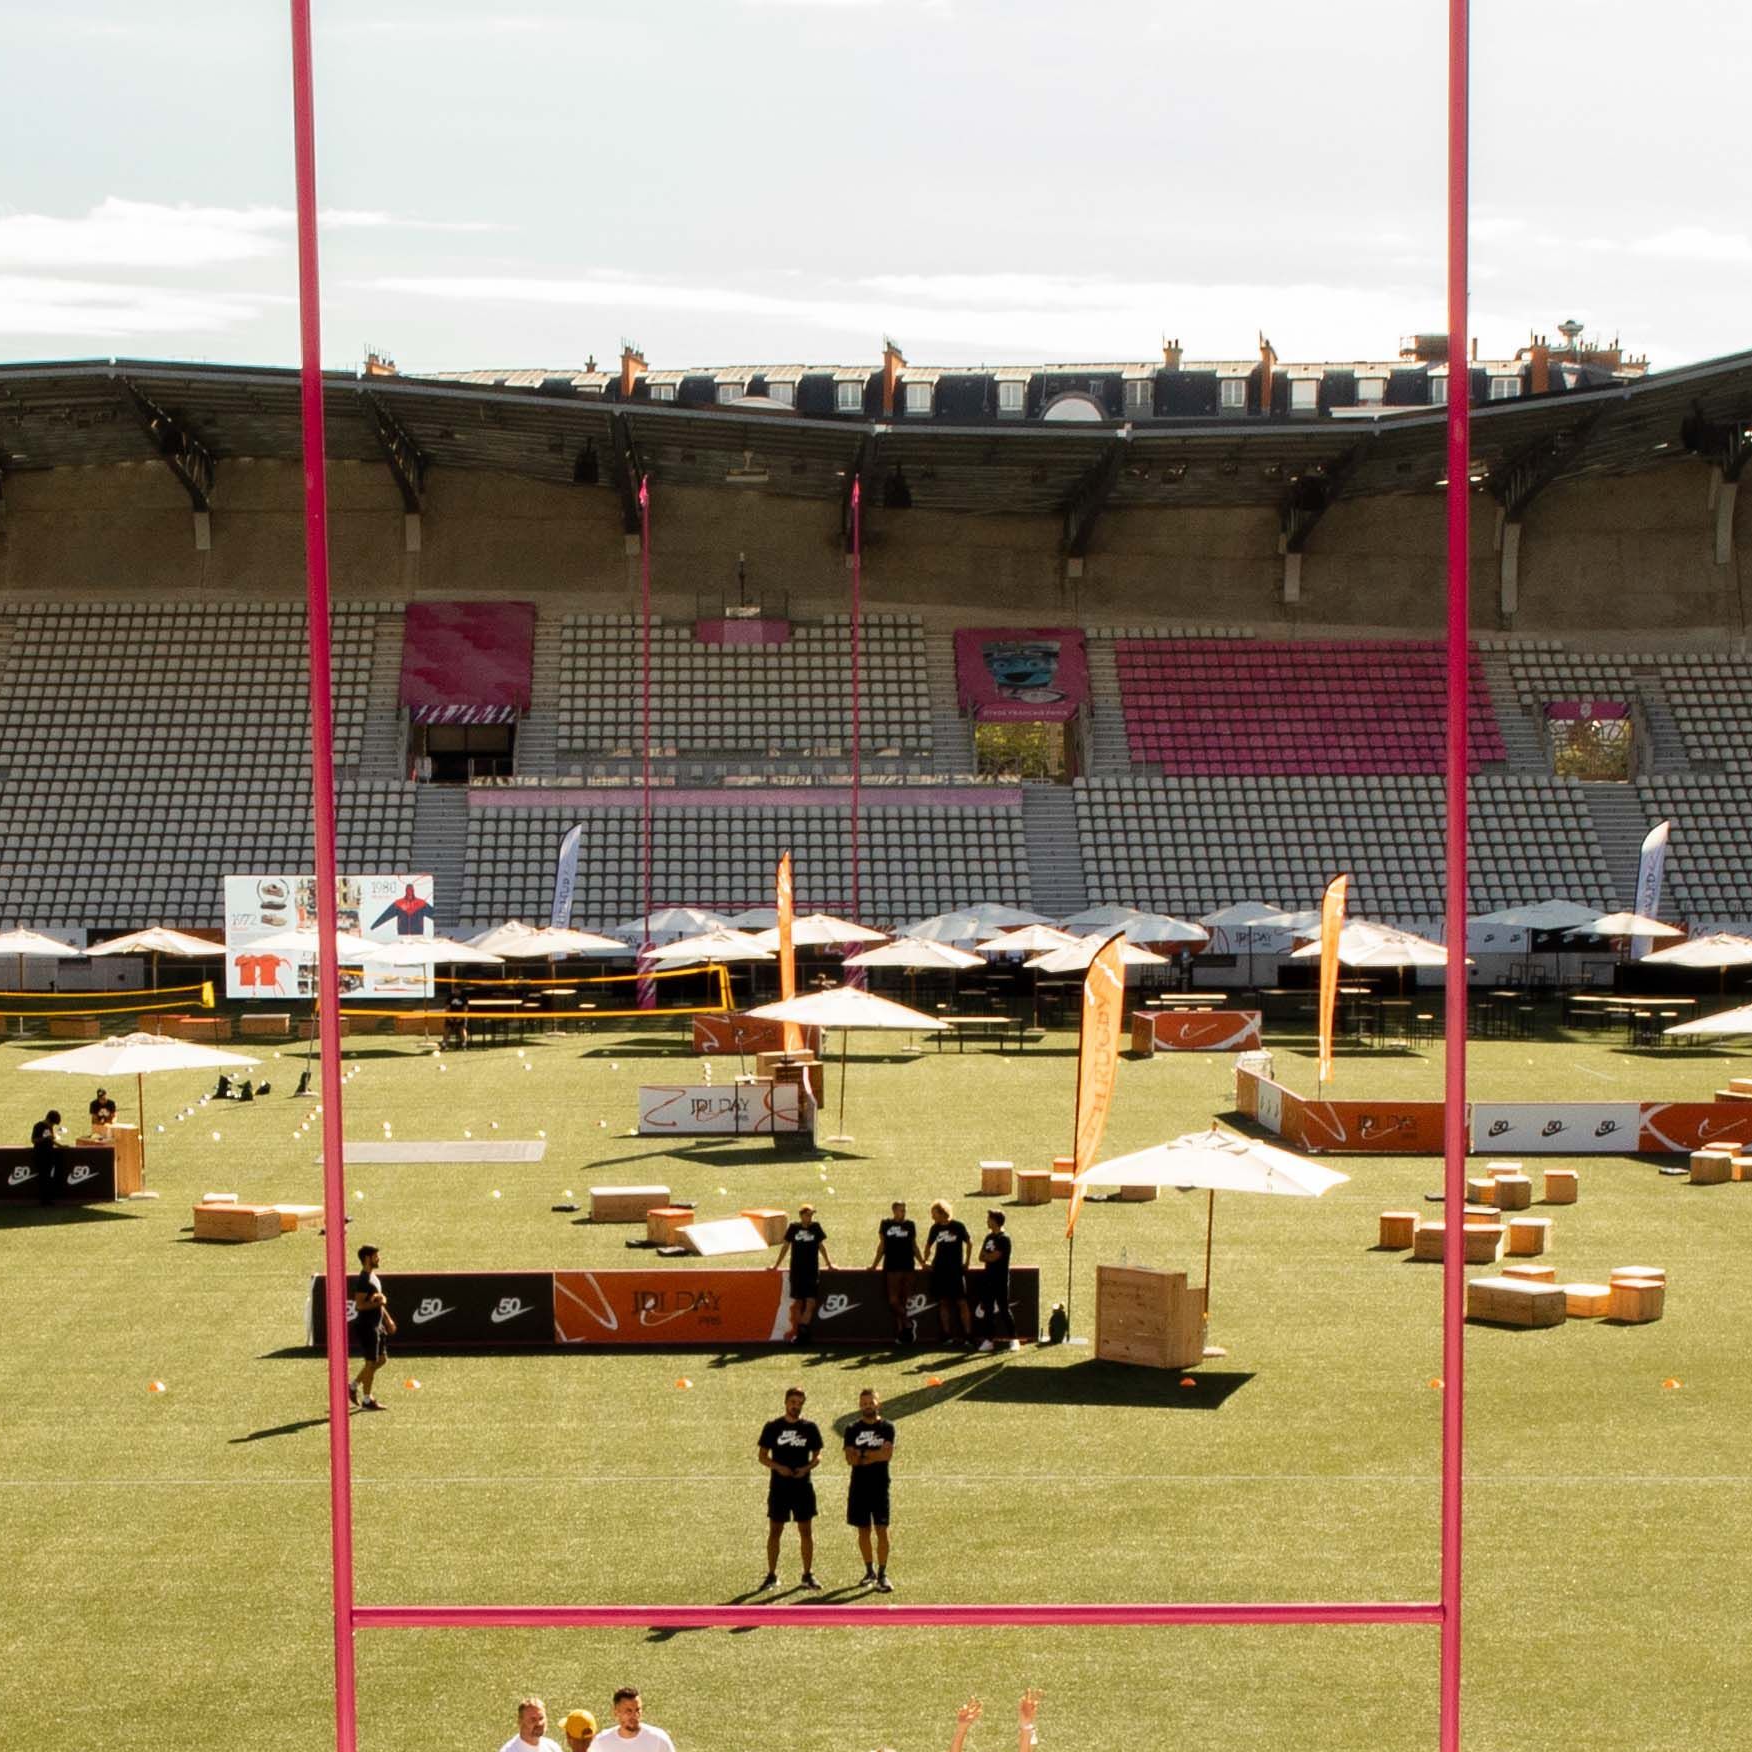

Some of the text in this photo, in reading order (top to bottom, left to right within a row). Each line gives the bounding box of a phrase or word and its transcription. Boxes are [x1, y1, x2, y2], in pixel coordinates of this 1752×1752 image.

[371, 881, 397, 895] 1980
[695, 1098, 751, 1115] JDI DAY
[1493, 1120, 1616, 1130] 50 50 50
[14, 1166, 30, 1178] 50
[73, 1165, 90, 1178] 50
[420, 1297, 521, 1314] 50 50
[826, 1293, 927, 1310] 50 50
